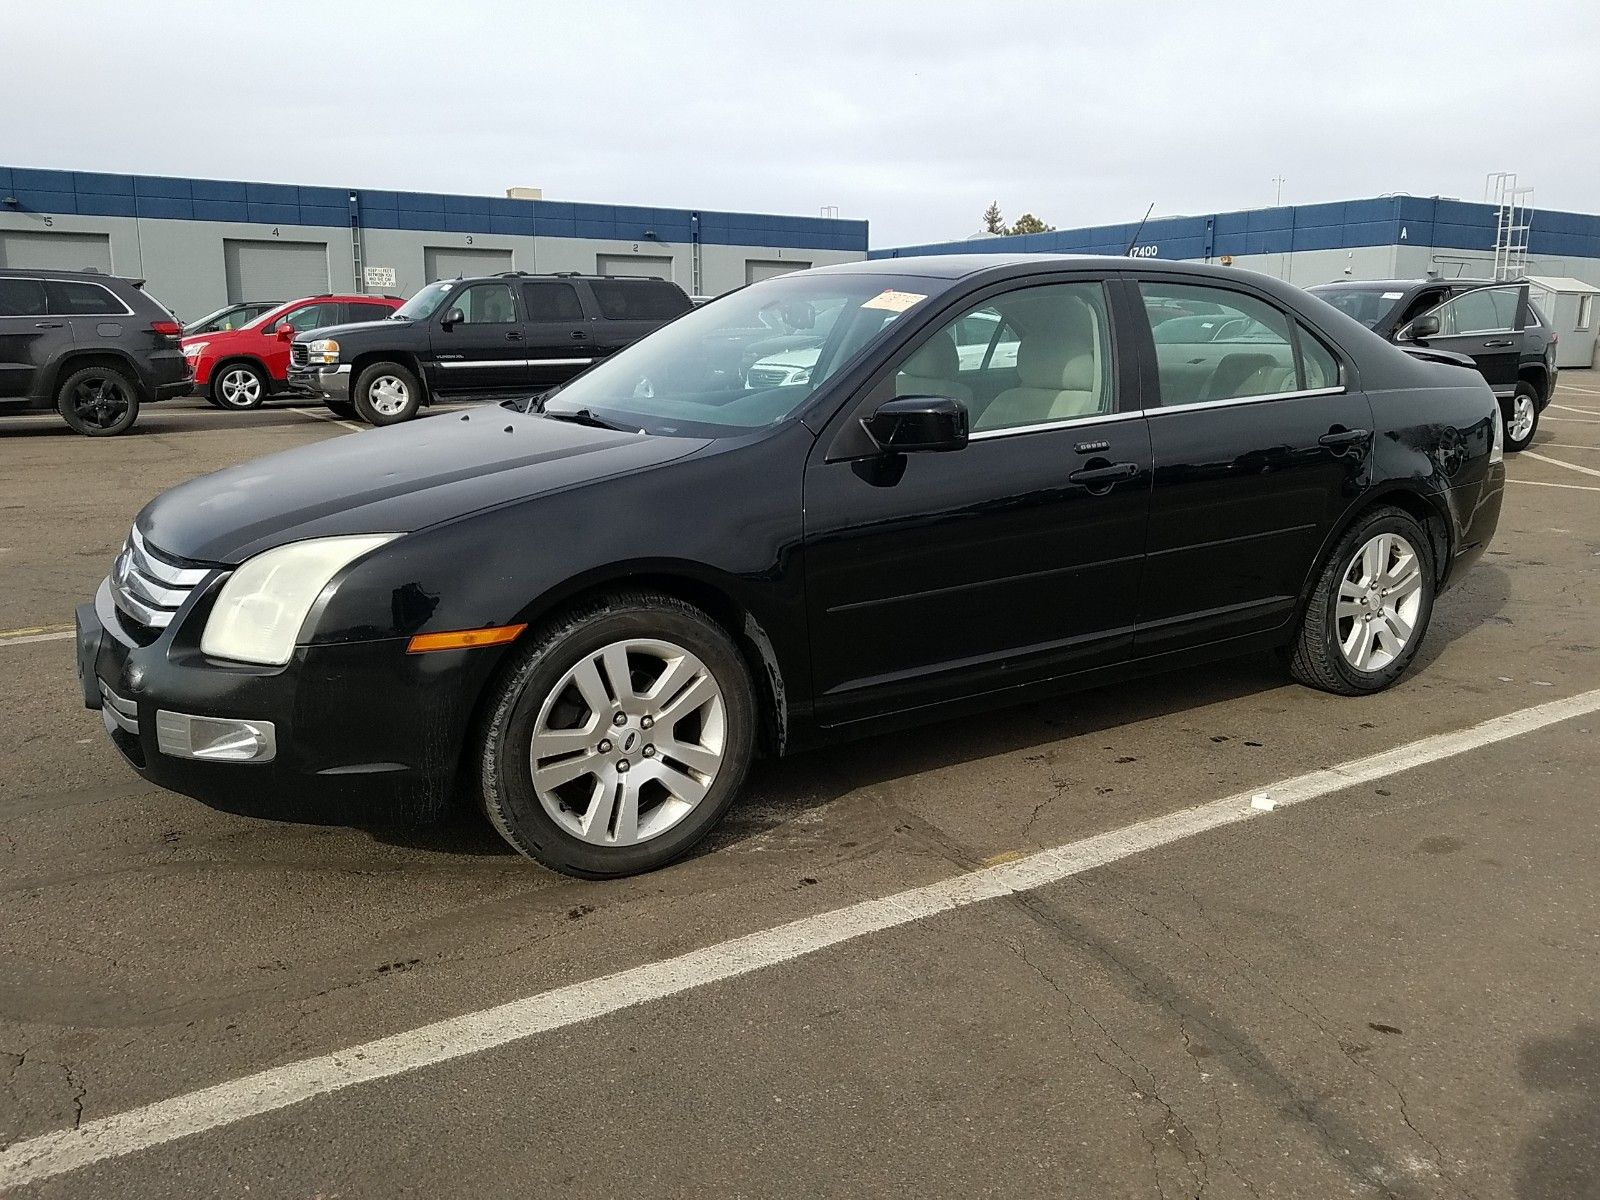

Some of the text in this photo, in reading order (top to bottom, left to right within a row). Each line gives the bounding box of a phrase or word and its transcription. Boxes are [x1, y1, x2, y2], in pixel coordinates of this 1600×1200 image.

[43, 216, 53, 227] 5
[272, 227, 280, 237] 4
[1400, 226, 1407, 239] A
[466, 236, 473, 245] 3
[633, 243, 639, 252] 2
[1129, 245, 1158, 257] 17400
